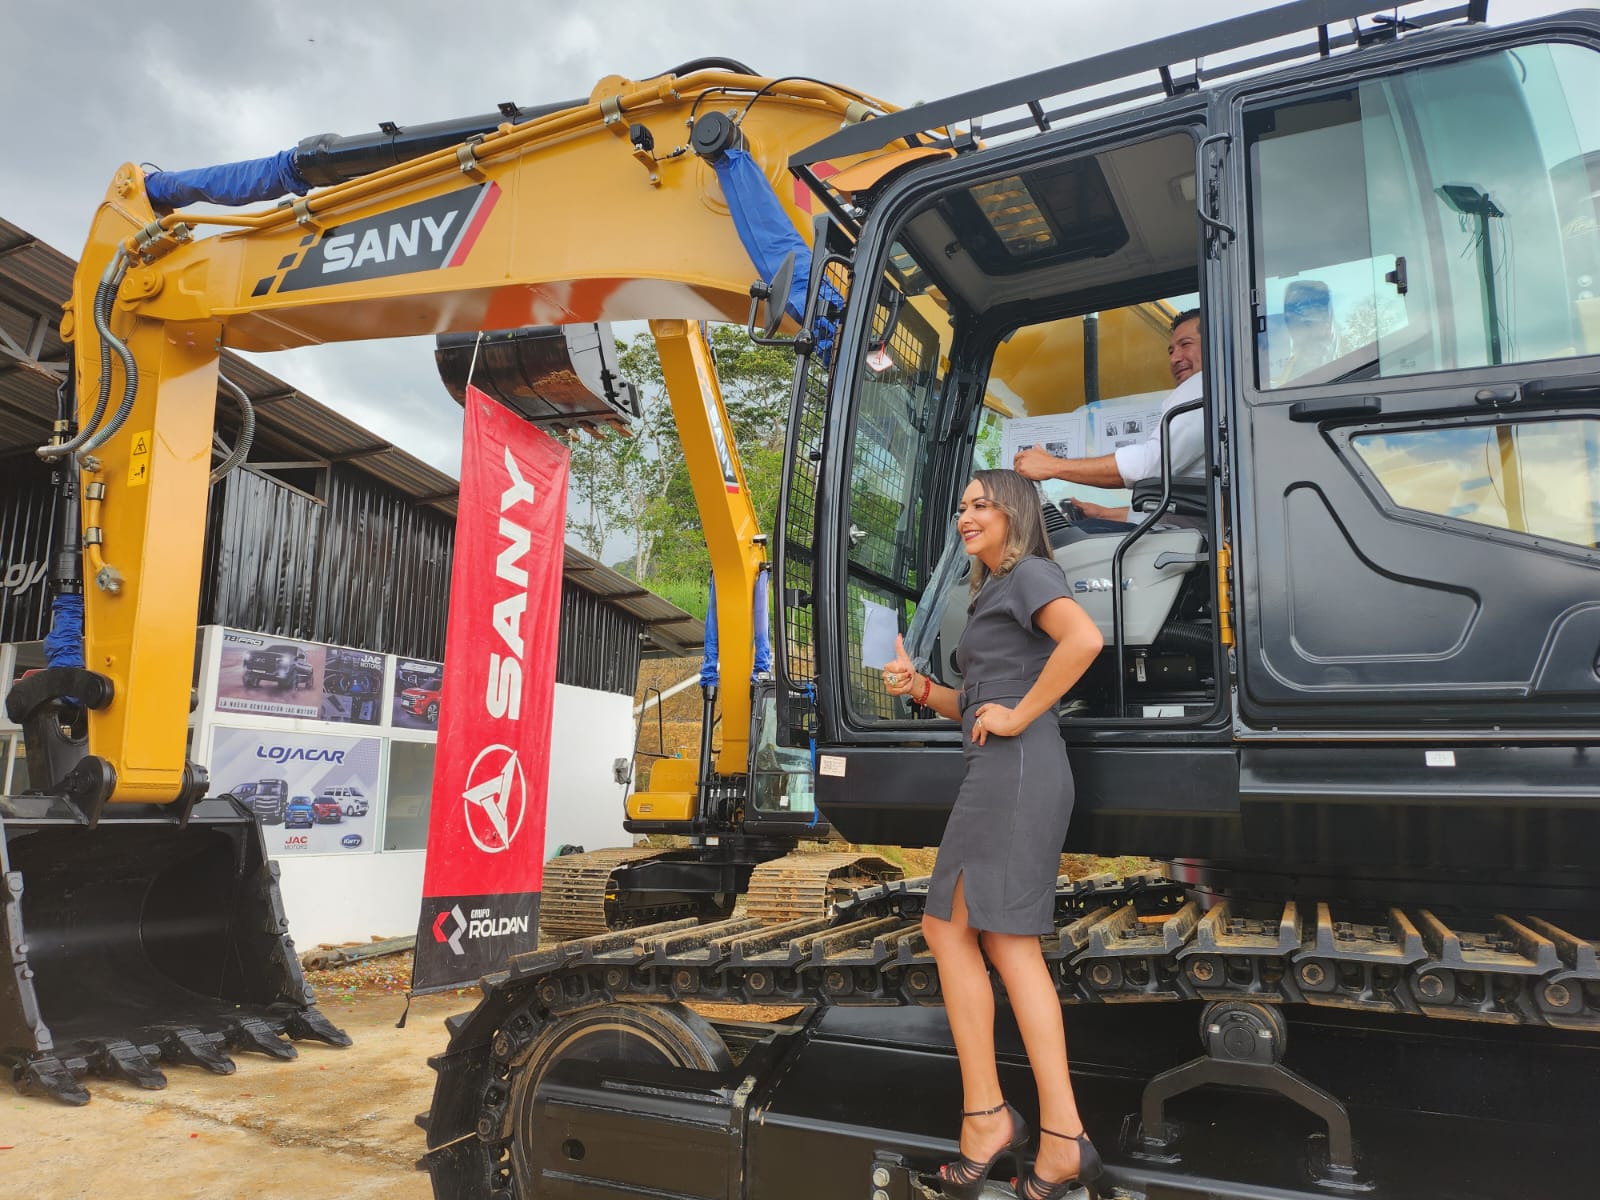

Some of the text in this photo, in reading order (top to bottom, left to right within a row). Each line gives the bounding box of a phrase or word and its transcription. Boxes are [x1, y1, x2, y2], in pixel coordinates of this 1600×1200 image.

[322, 210, 459, 274] SANY
[486, 445, 535, 721] SANY
[361, 655, 382, 665] JAC
[256, 745, 345, 764] LOJACAR
[285, 836, 308, 844] JAC
[470, 908, 490, 919] GRUPO
[468, 915, 529, 939] ROLDAN
